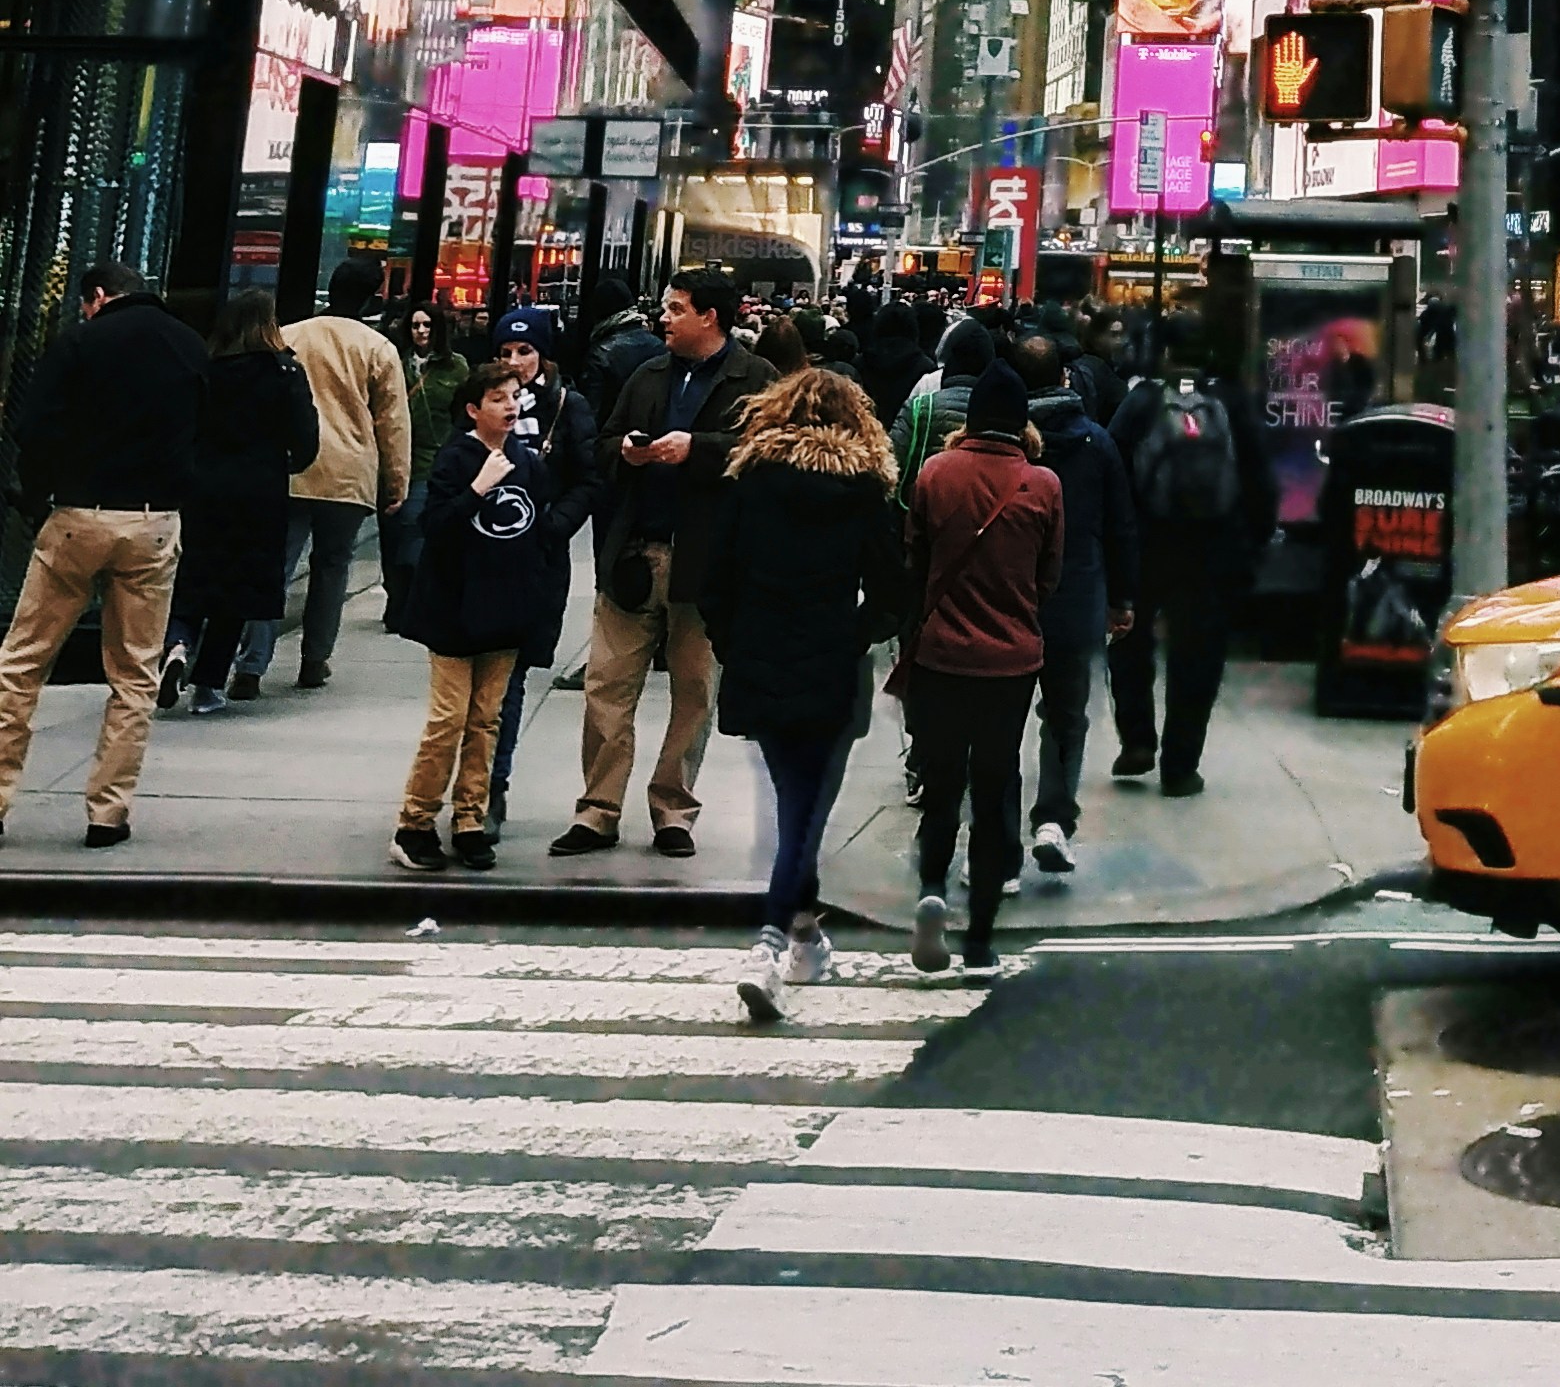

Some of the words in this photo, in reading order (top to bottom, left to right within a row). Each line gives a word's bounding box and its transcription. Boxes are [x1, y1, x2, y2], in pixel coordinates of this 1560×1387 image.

[1268, 372, 1320, 391] YOUR
[1265, 400, 1344, 428] SHINE
[1354, 488, 1445, 510] BROADWAY'S
